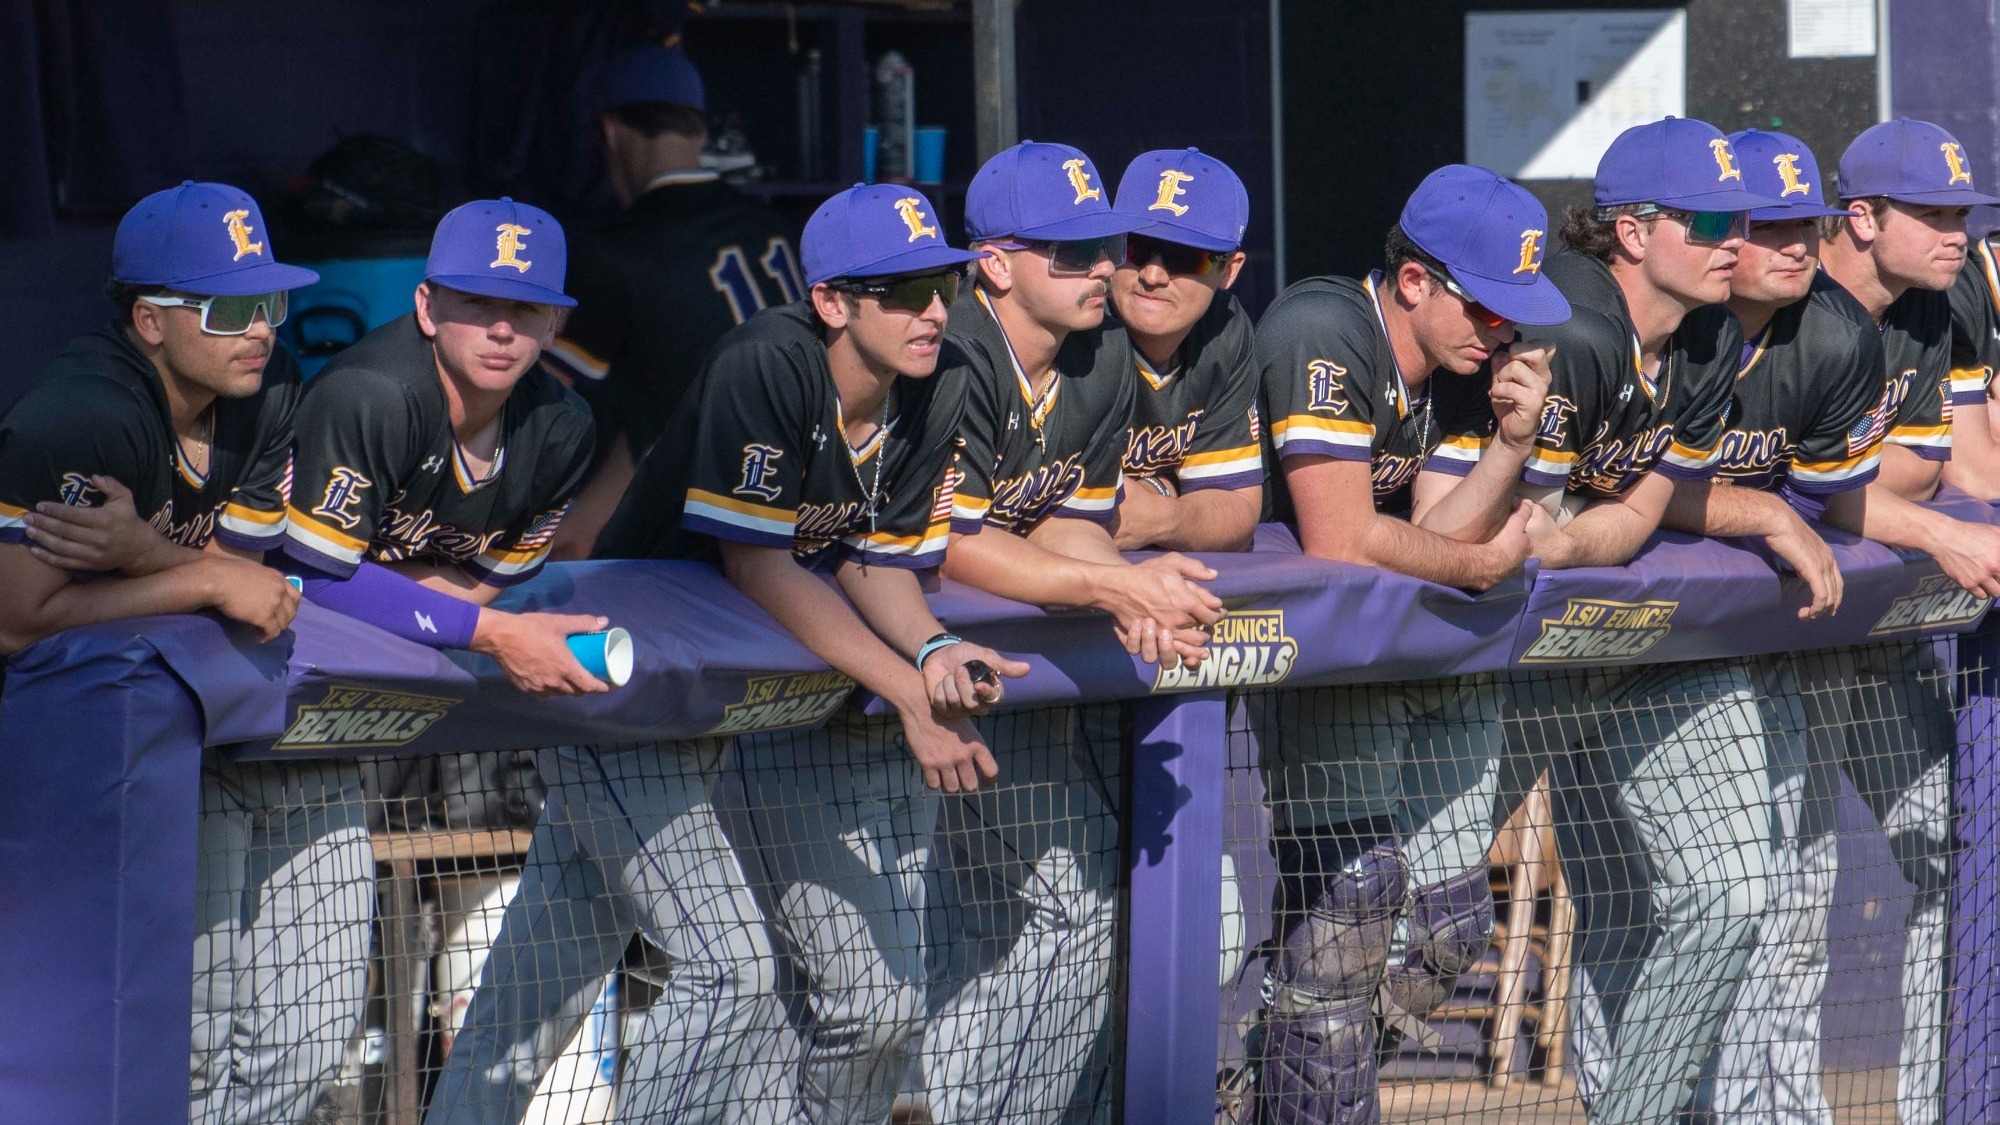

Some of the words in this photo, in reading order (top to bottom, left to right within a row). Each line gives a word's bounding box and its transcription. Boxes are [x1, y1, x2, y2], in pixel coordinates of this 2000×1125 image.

[709, 236, 802, 325] 11
[1213, 617, 1279, 643] EUNICE
[1564, 604, 1607, 626] LSU
[1603, 607, 1673, 629] EUNICE
[1527, 627, 1666, 657] BENGALS
[323, 690, 371, 709] LSU
[365, 694, 450, 712] EUNICE
[746, 678, 785, 704] LSU
[784, 670, 850, 698] EUNICE
[714, 688, 851, 733] BENGALS
[281, 711, 441, 744] BENGALS
